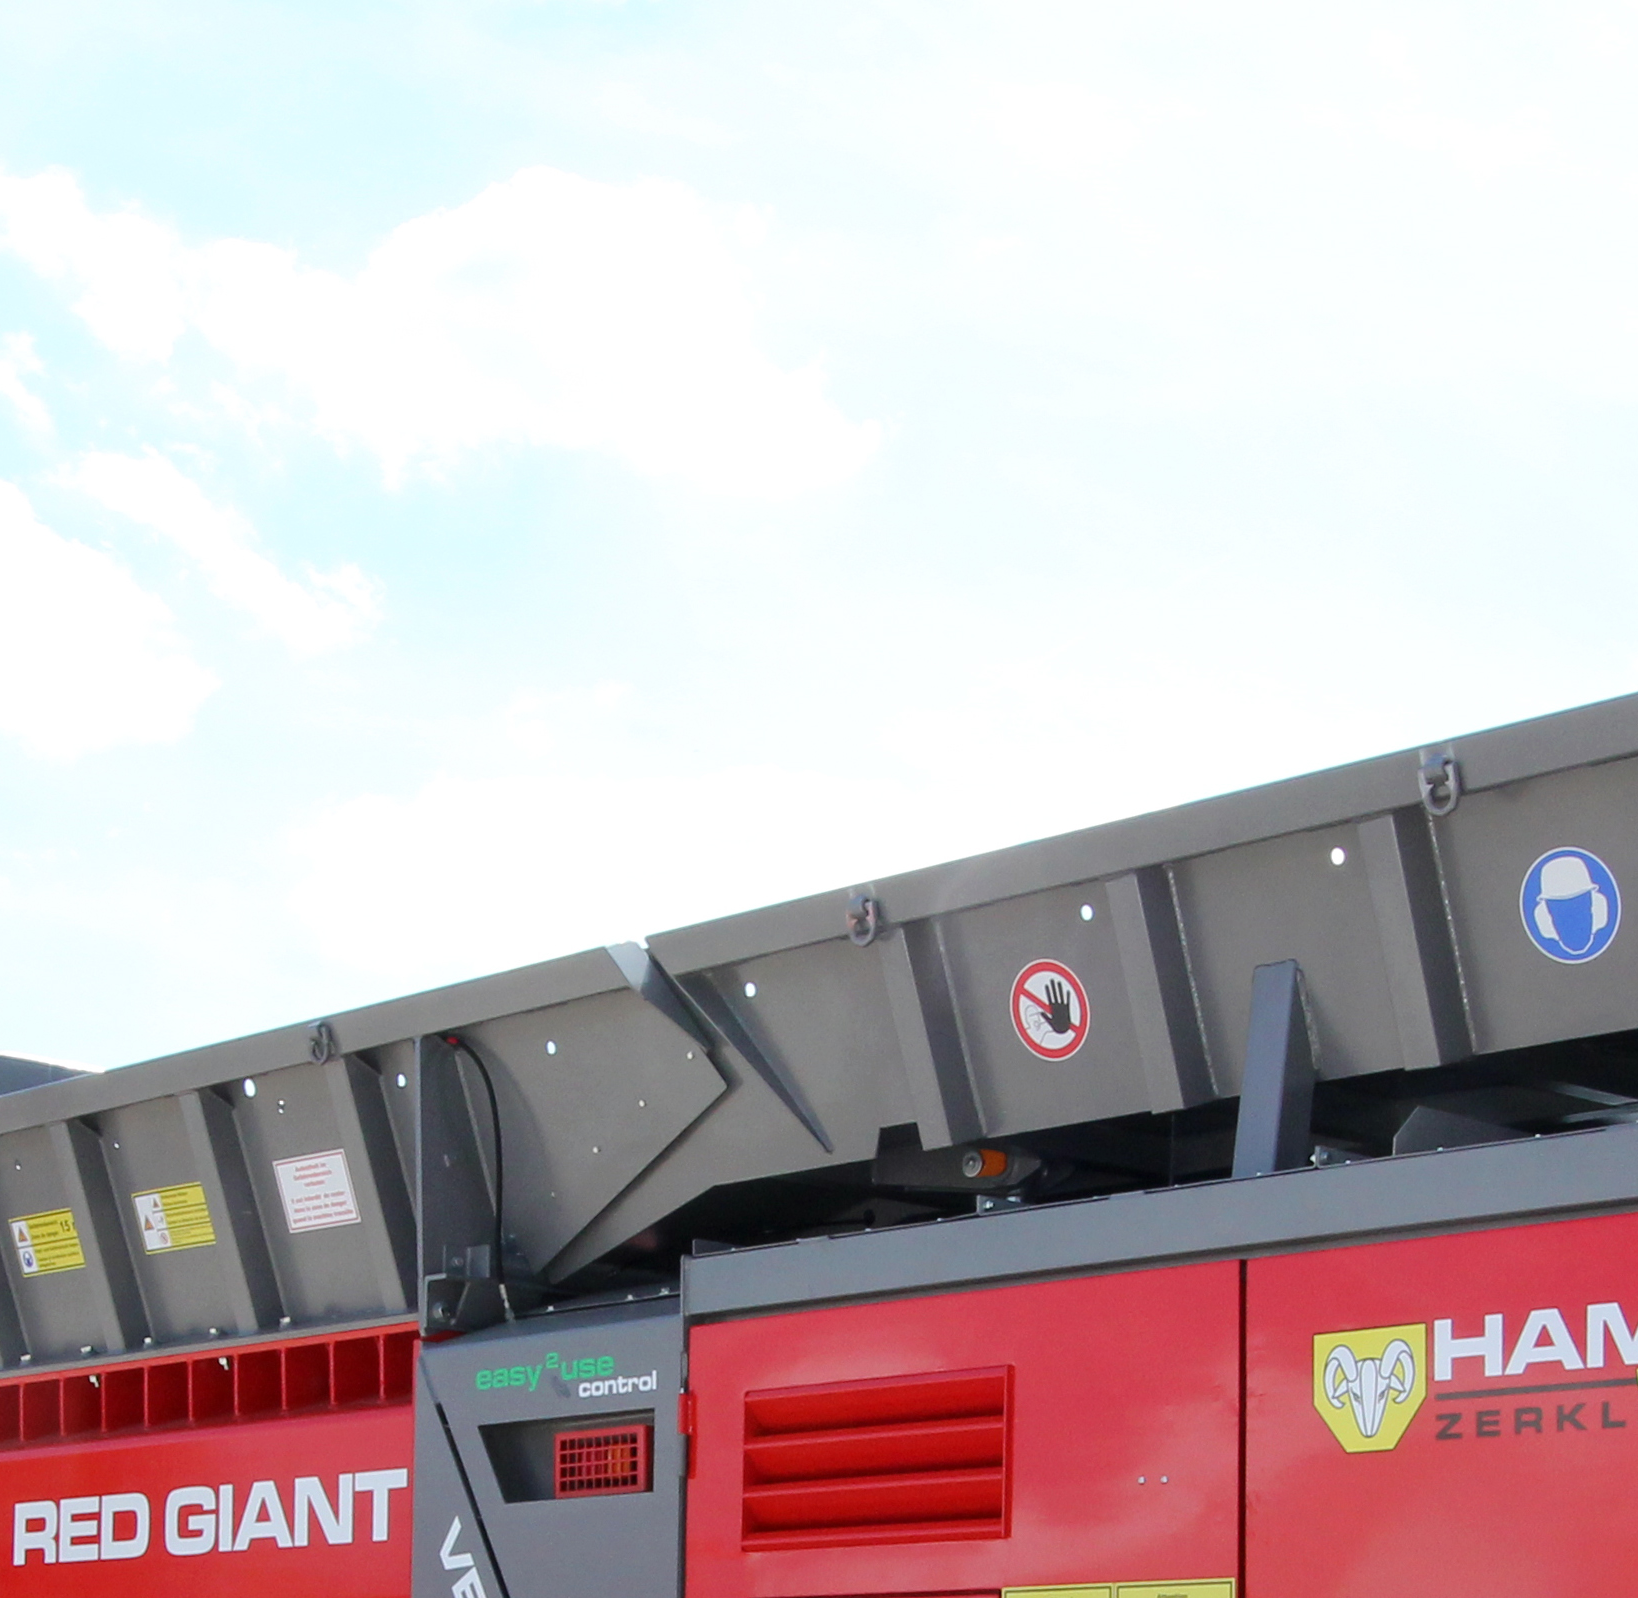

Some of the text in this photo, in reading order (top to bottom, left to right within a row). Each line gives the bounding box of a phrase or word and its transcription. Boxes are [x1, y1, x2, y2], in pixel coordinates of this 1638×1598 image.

[578, 1370, 657, 1398] control
[12, 1468, 409, 1567] RED GIANT
